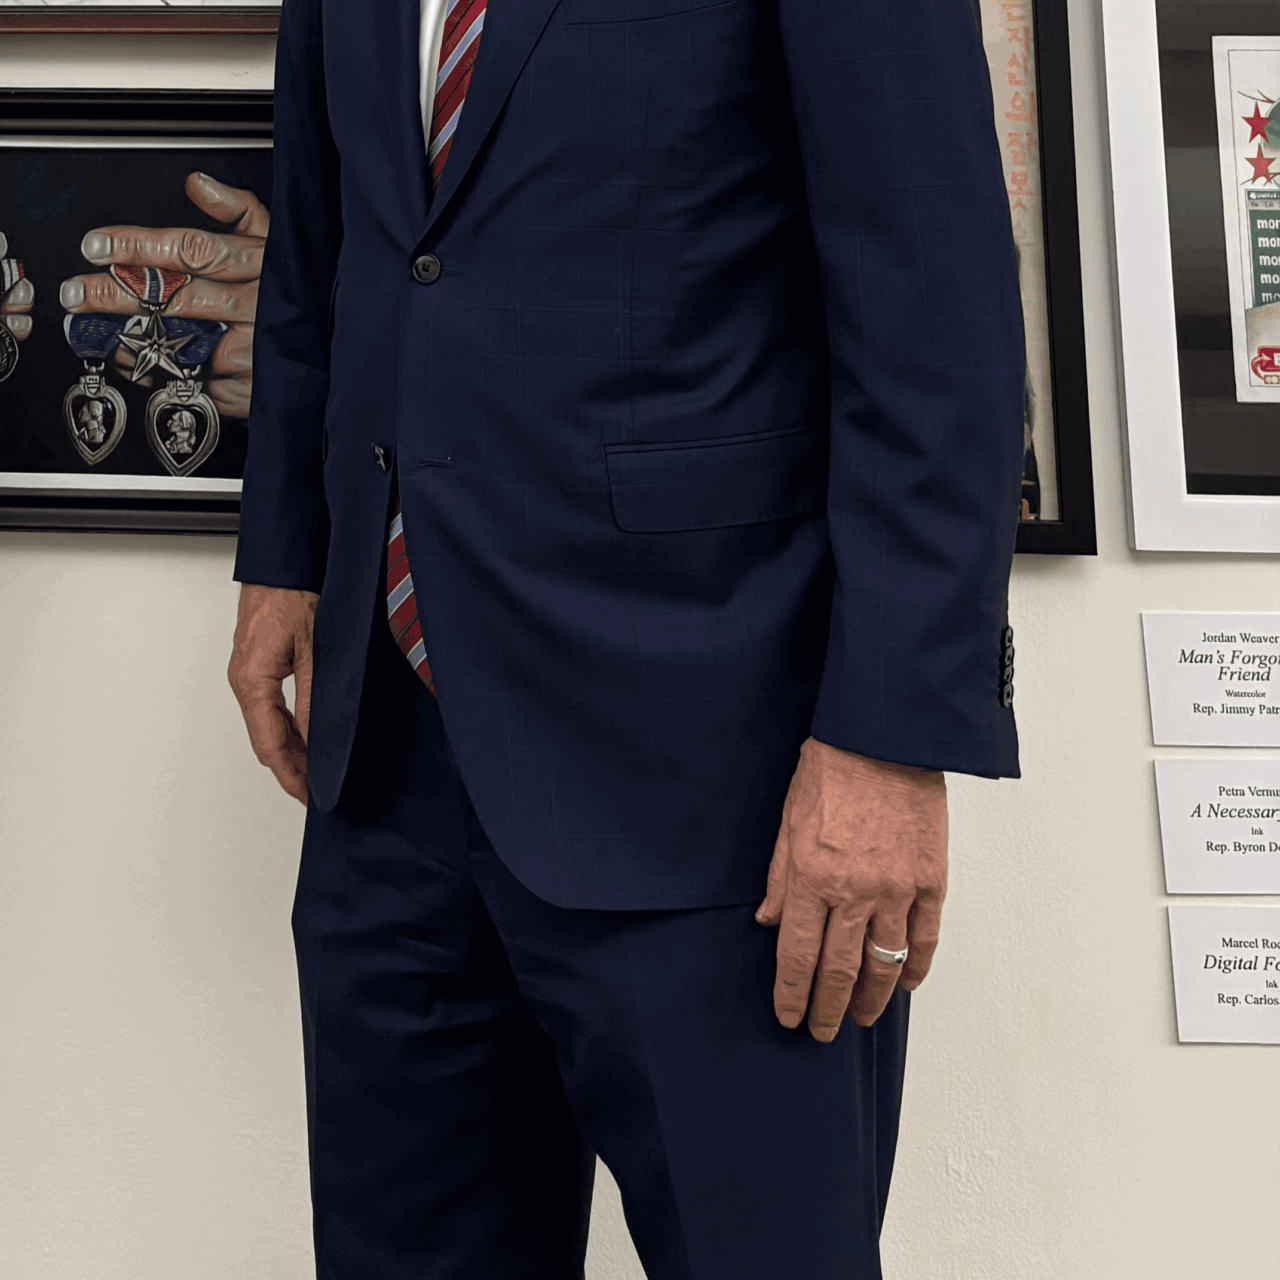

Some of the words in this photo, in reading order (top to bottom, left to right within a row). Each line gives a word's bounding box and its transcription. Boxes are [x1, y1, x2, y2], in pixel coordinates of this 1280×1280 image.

[1202, 633, 1237, 643] Jordan
[1239, 633, 1279, 643] Weaver
[1178, 649, 1225, 664] Man's
[1218, 666, 1271, 681] Friend
[1225, 689, 1266, 698] Watercolor
[1193, 703, 1217, 716] Rep.
[1220, 704, 1255, 716] Jimmy
[1219, 786, 1245, 796] Petra
[1190, 803, 1202, 817] A
[1251, 827, 1263, 835] Ink
[1206, 841, 1230, 854] Rep.
[1233, 842, 1266, 854] Byron
[1222, 938, 1258, 948] Marcel
[1203, 955, 1258, 974] Digital
[1266, 980, 1278, 988] Ink
[1217, 993, 1241, 1006] Rep.
[1244, 994, 1279, 1005] Carlos
